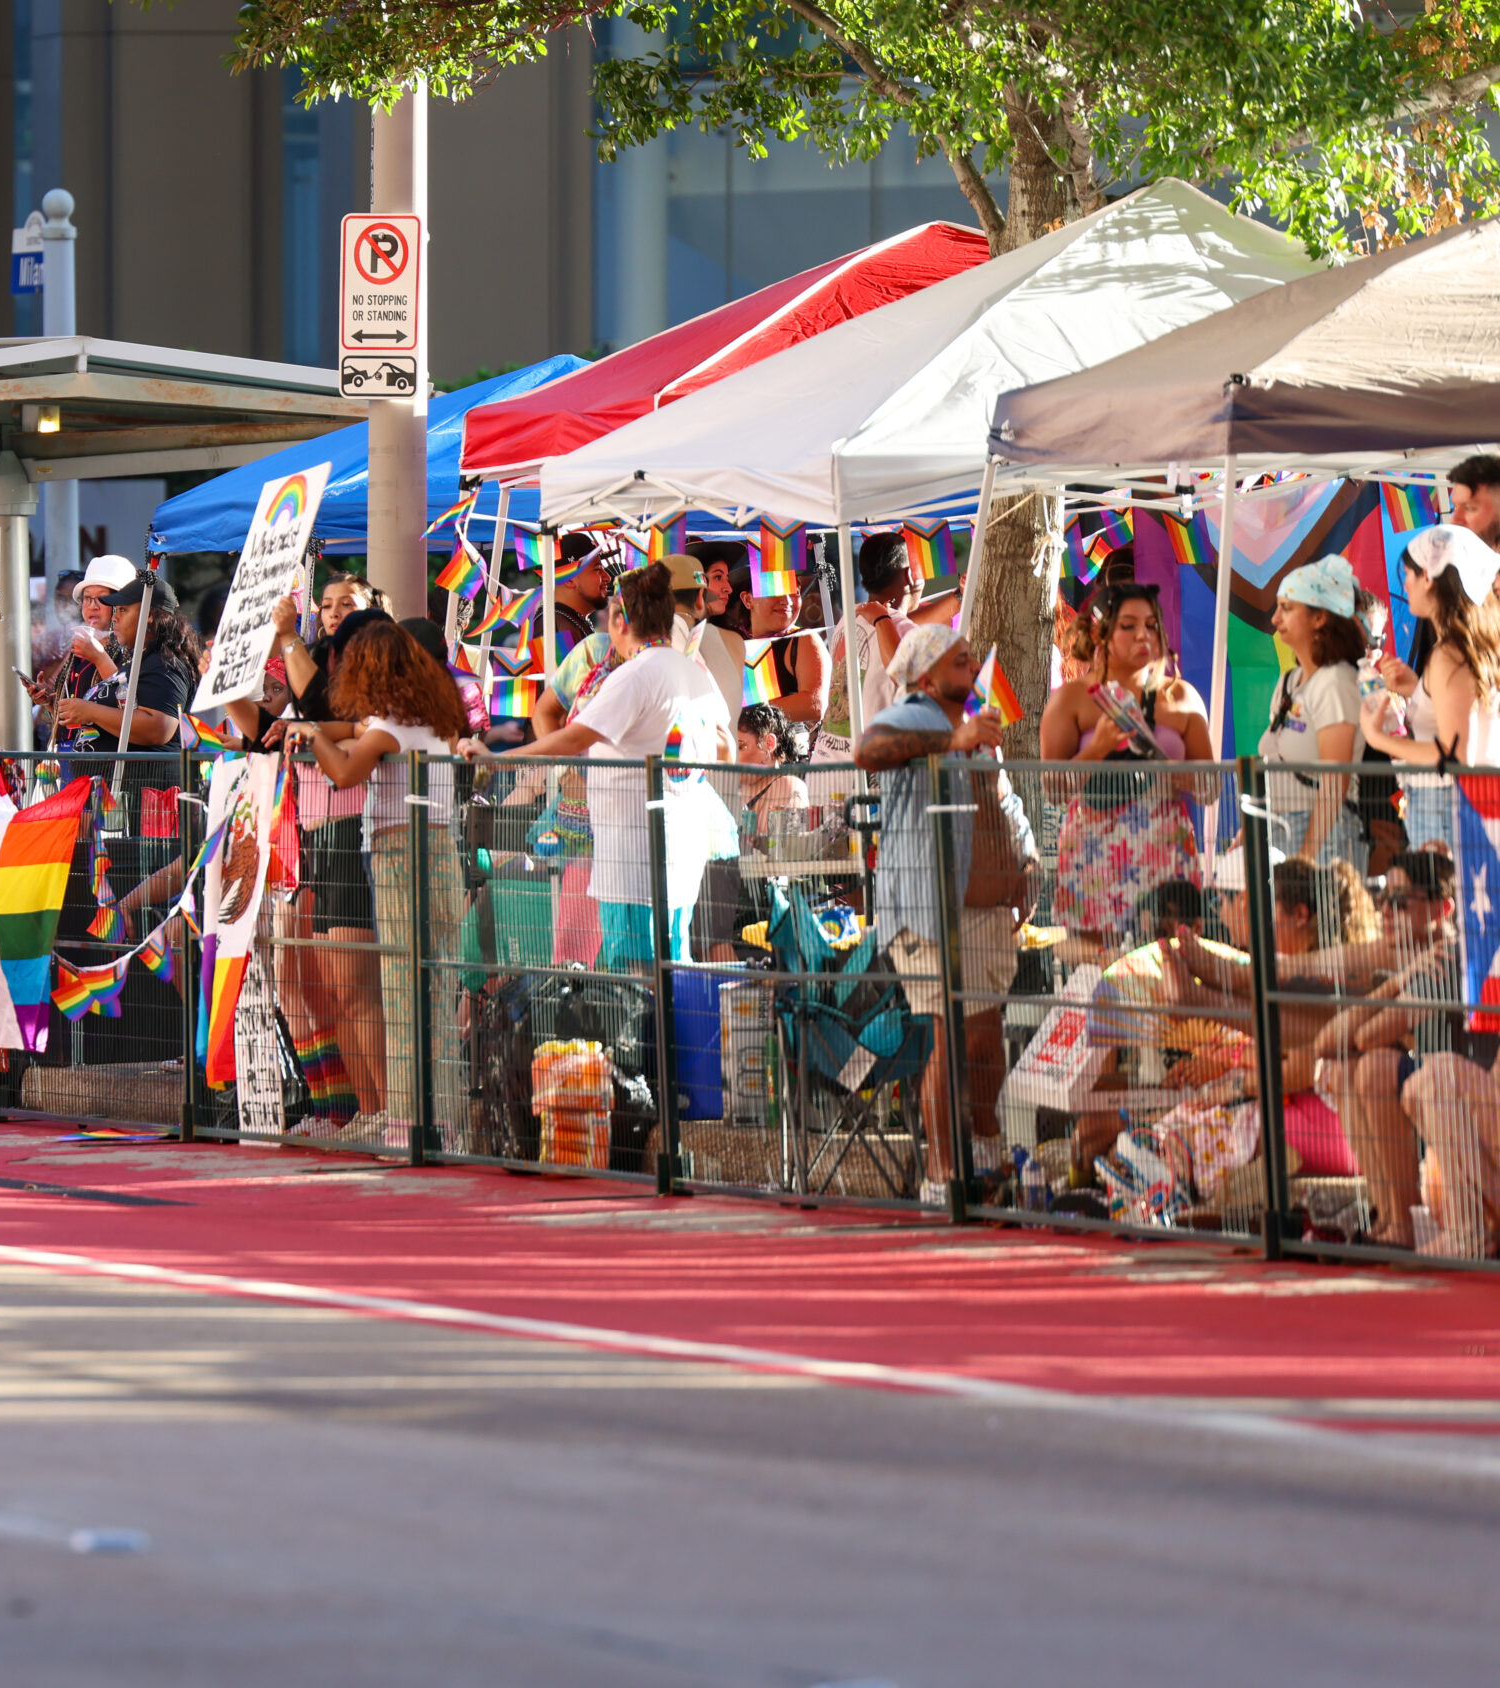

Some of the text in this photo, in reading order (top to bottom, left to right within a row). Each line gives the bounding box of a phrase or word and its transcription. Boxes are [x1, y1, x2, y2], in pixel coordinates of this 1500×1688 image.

[352, 295, 407, 306] NO STOPPING
[352, 310, 407, 321] OR STANDING
[825, 736, 851, 753] HOUR
